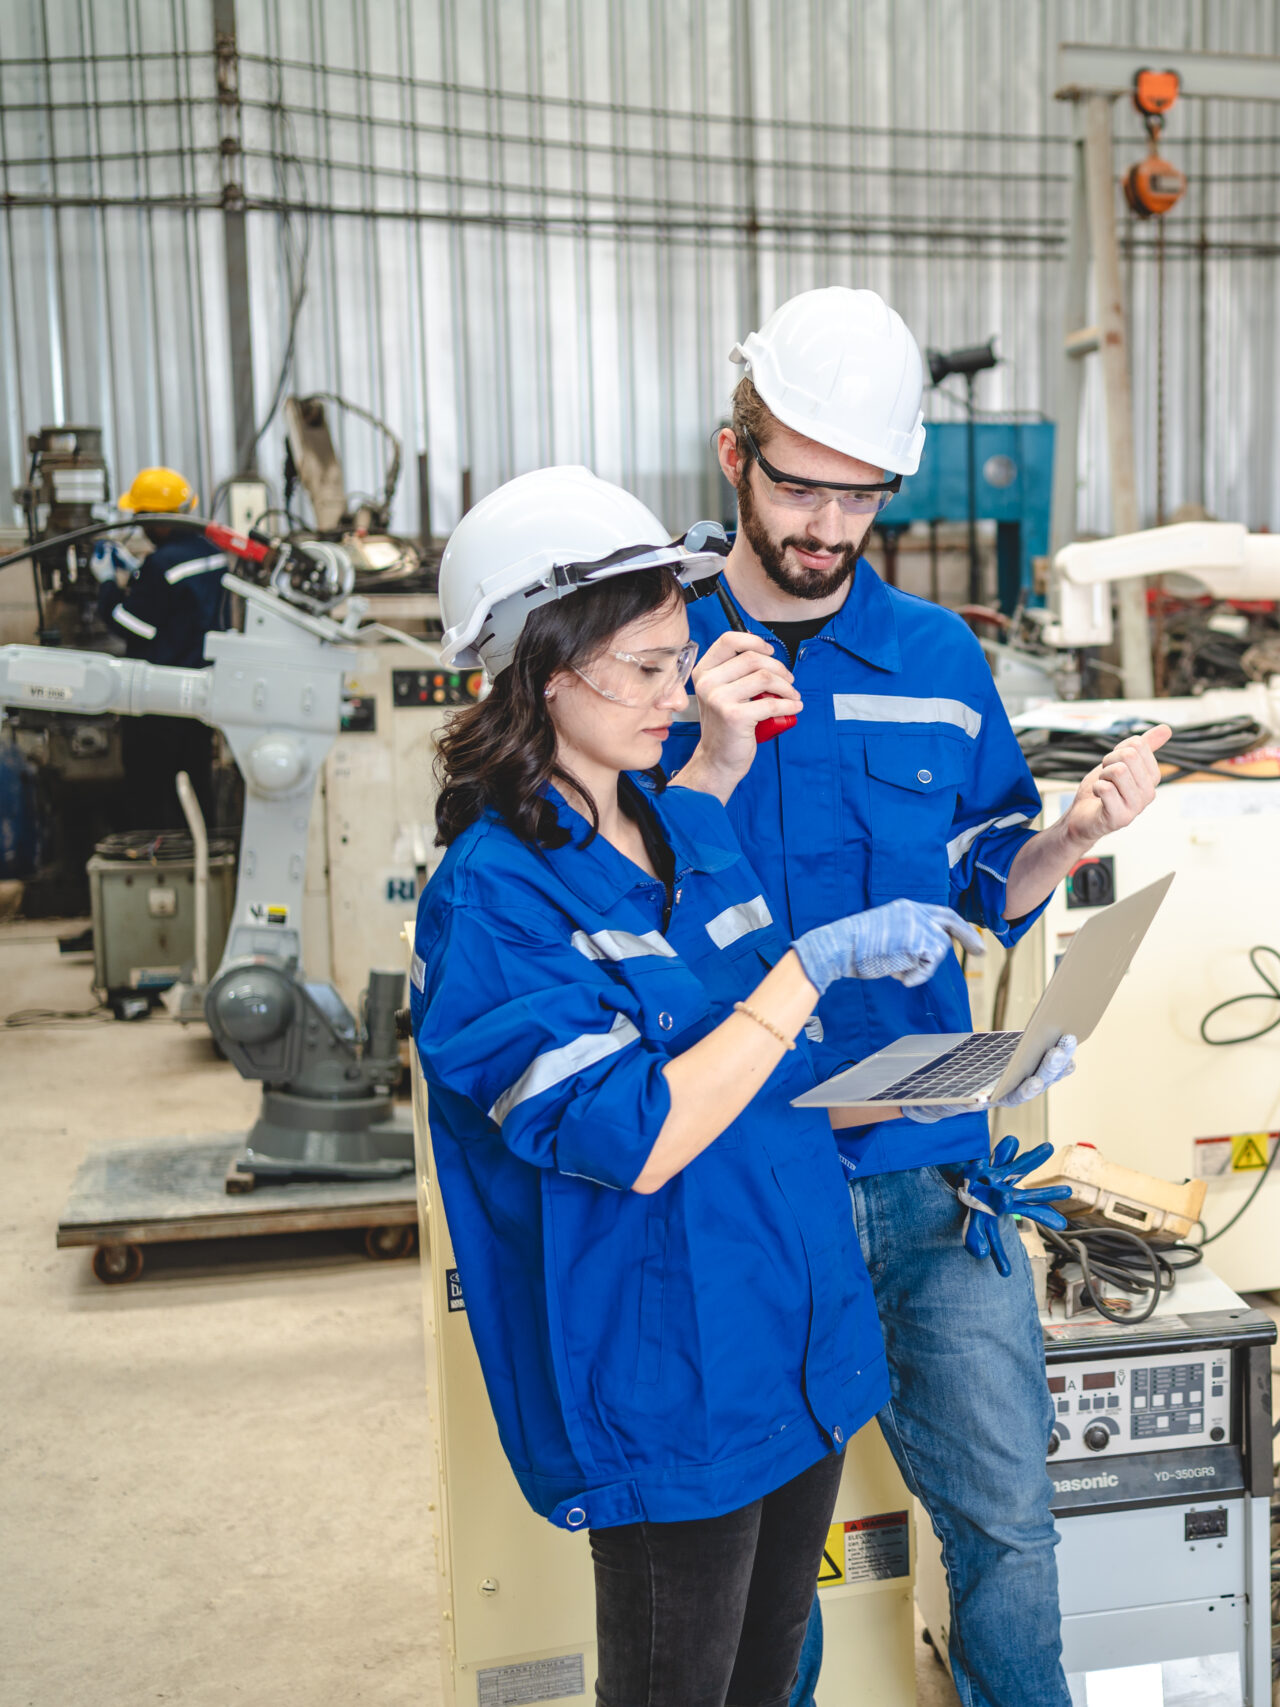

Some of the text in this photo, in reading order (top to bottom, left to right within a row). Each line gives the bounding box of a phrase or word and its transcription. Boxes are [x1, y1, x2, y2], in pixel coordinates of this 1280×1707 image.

[1067, 1380, 1077, 1391] A
[1117, 1375, 1126, 1386] V
[1154, 1466, 1216, 1482] YD-350GR3
[1053, 1472, 1119, 1493] nasonic
[498, 1659, 566, 1675] TRANSFORMER
